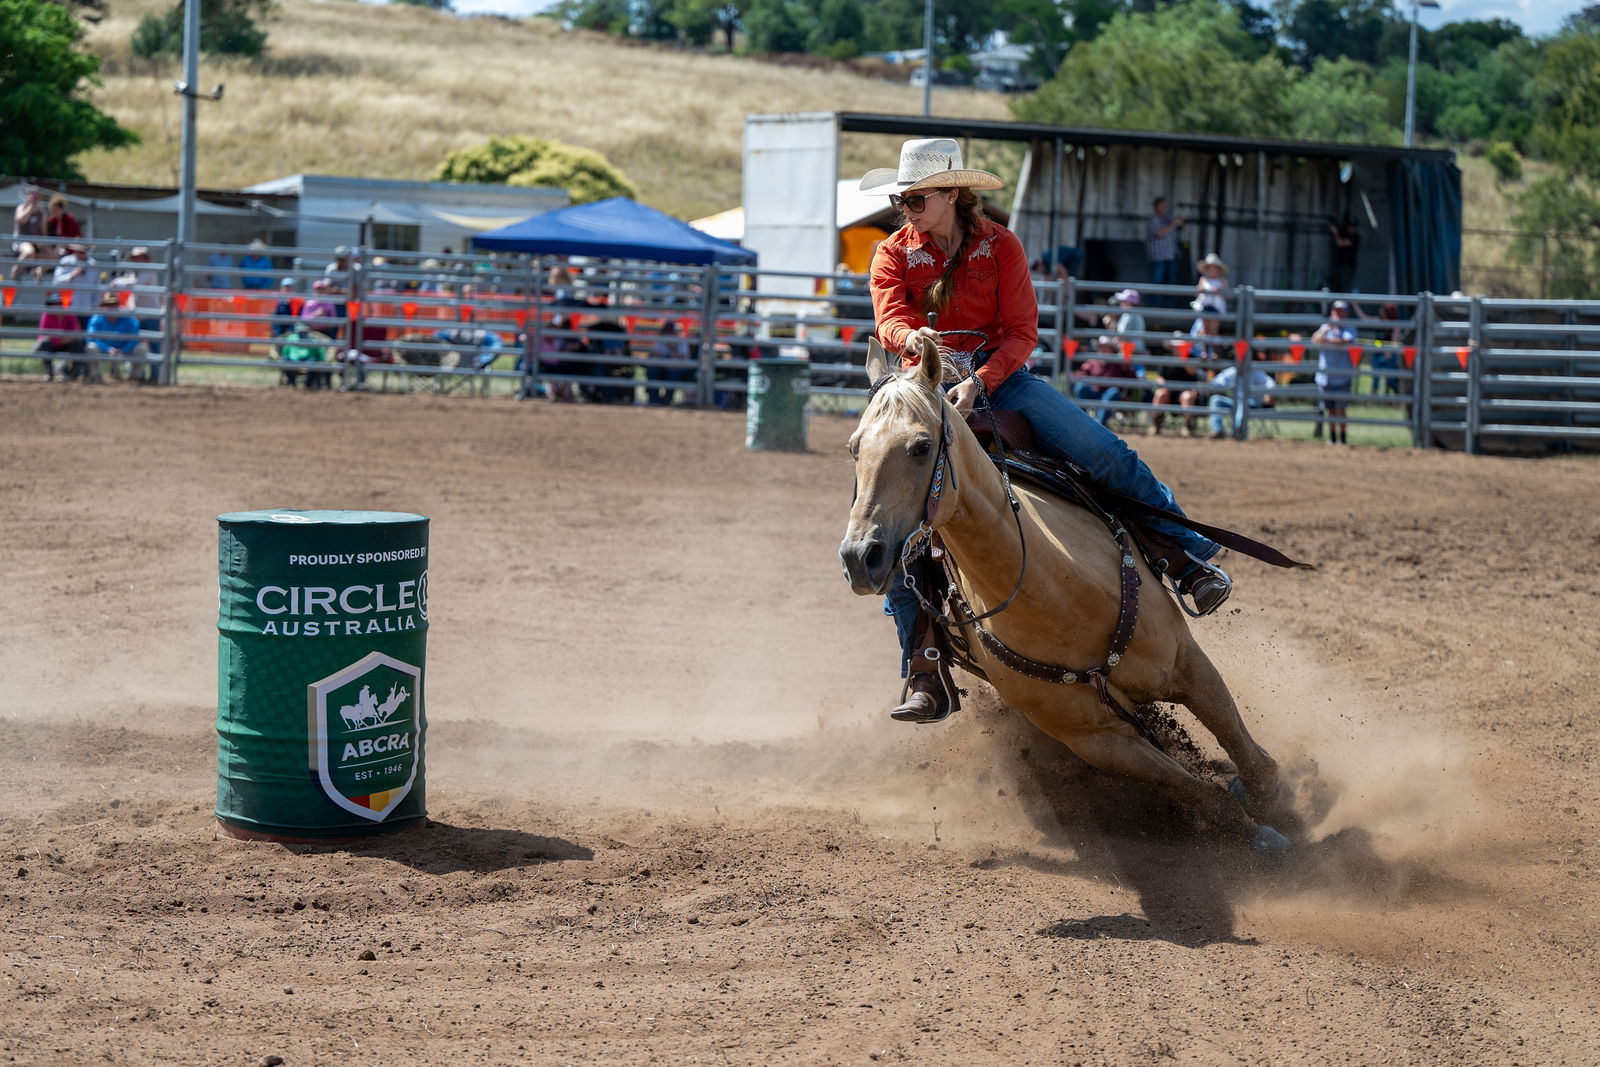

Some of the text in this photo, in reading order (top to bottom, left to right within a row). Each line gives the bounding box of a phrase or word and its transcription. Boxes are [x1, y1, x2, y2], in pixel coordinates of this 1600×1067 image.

[289, 554, 354, 565] PROUDLY
[356, 548, 420, 564] SPONSORED
[256, 580, 416, 615] CIRCLE
[262, 615, 416, 636] AUSTRALIA
[341, 732, 410, 762] ABCRA
[354, 763, 403, 781] EST 1946
